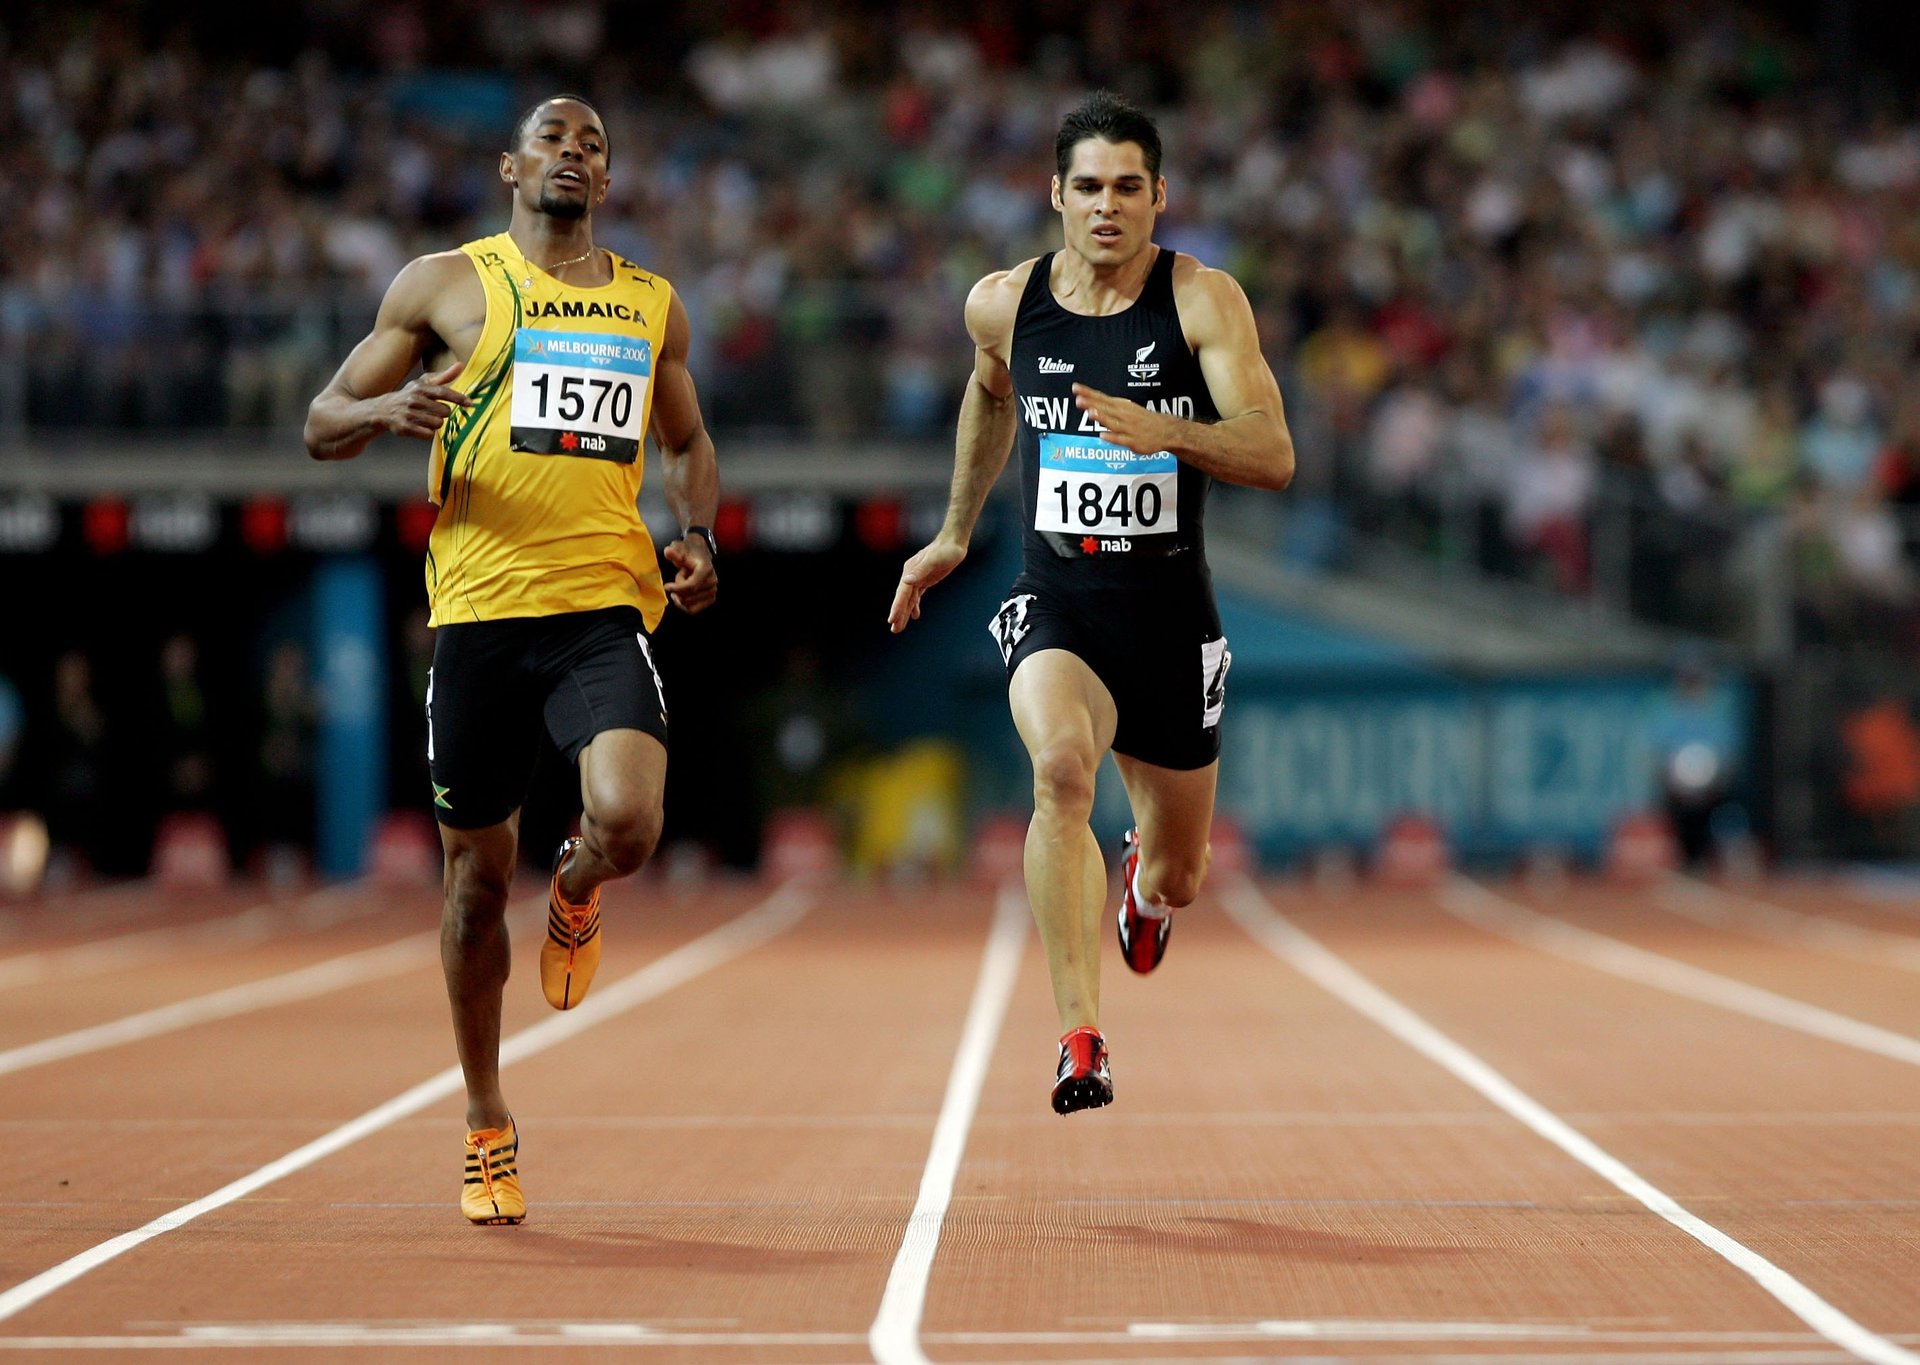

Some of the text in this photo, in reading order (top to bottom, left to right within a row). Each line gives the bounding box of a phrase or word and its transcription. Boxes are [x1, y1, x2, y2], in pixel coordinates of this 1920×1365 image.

[525, 301, 648, 328] JAMAICA
[547, 339, 646, 363] MELBOURNE 2006
[1037, 356, 1075, 374] Union
[531, 373, 633, 428] 1570
[1020, 395, 1069, 430] NEW
[580, 435, 607, 452] nab
[1064, 446, 1137, 462] MELBOURNE
[1053, 480, 1162, 528] 1840
[1101, 538, 1132, 553] nab
